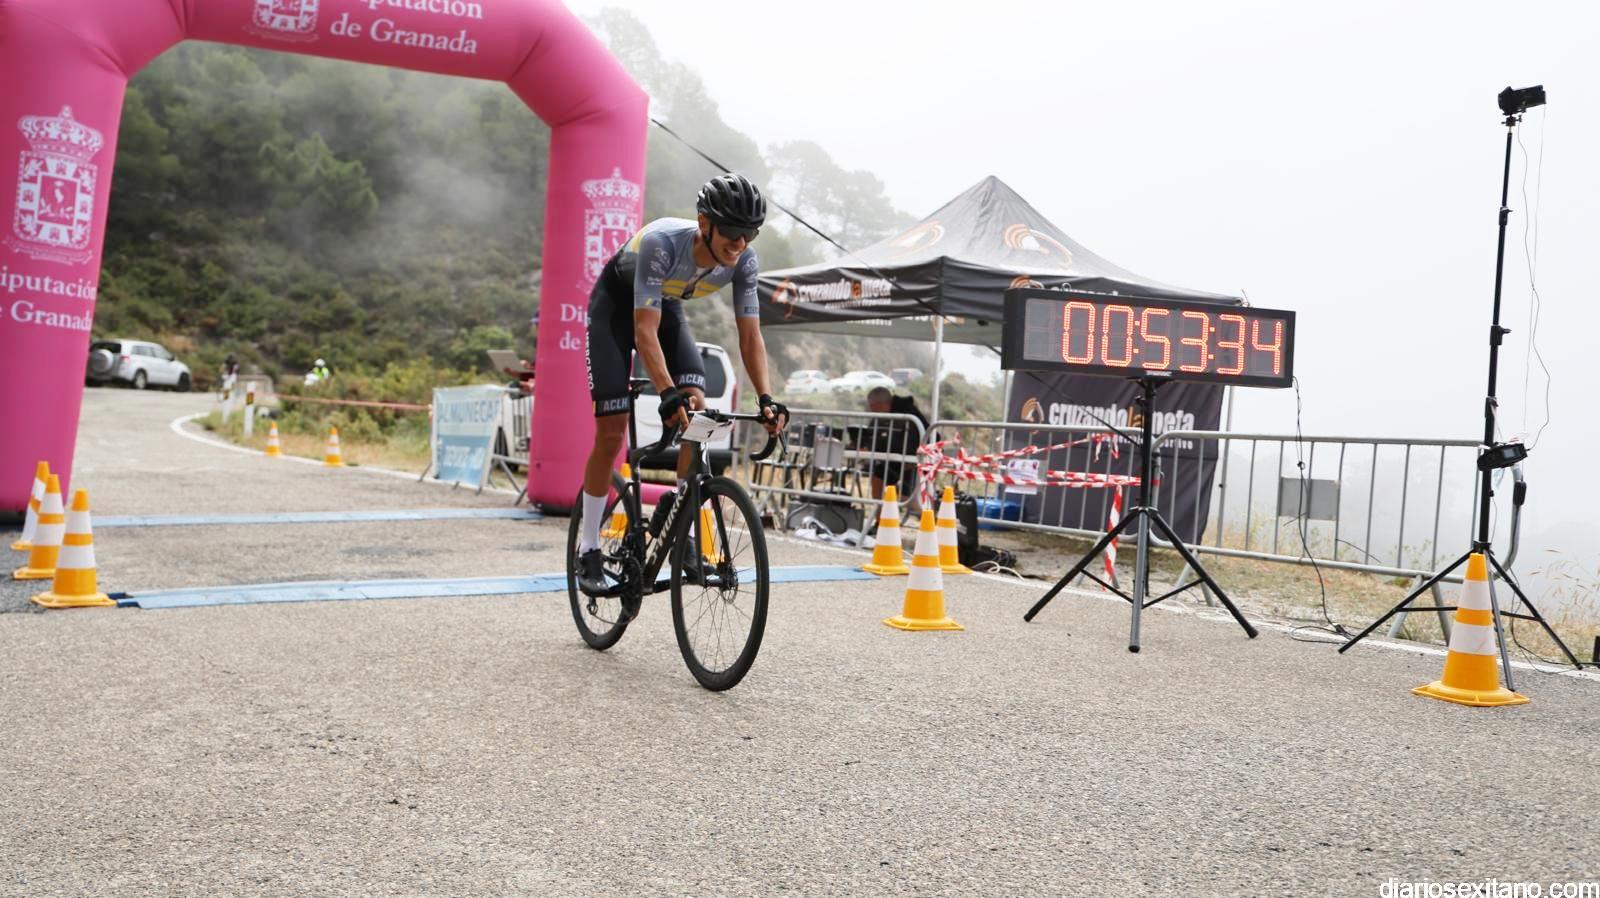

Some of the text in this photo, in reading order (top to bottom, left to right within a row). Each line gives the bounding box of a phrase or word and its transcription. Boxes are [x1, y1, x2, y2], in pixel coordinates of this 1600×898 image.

[330, 12, 478, 54] de Granada
[559, 330, 581, 350] de
[1062, 301, 1282, 375] 00:53:34
